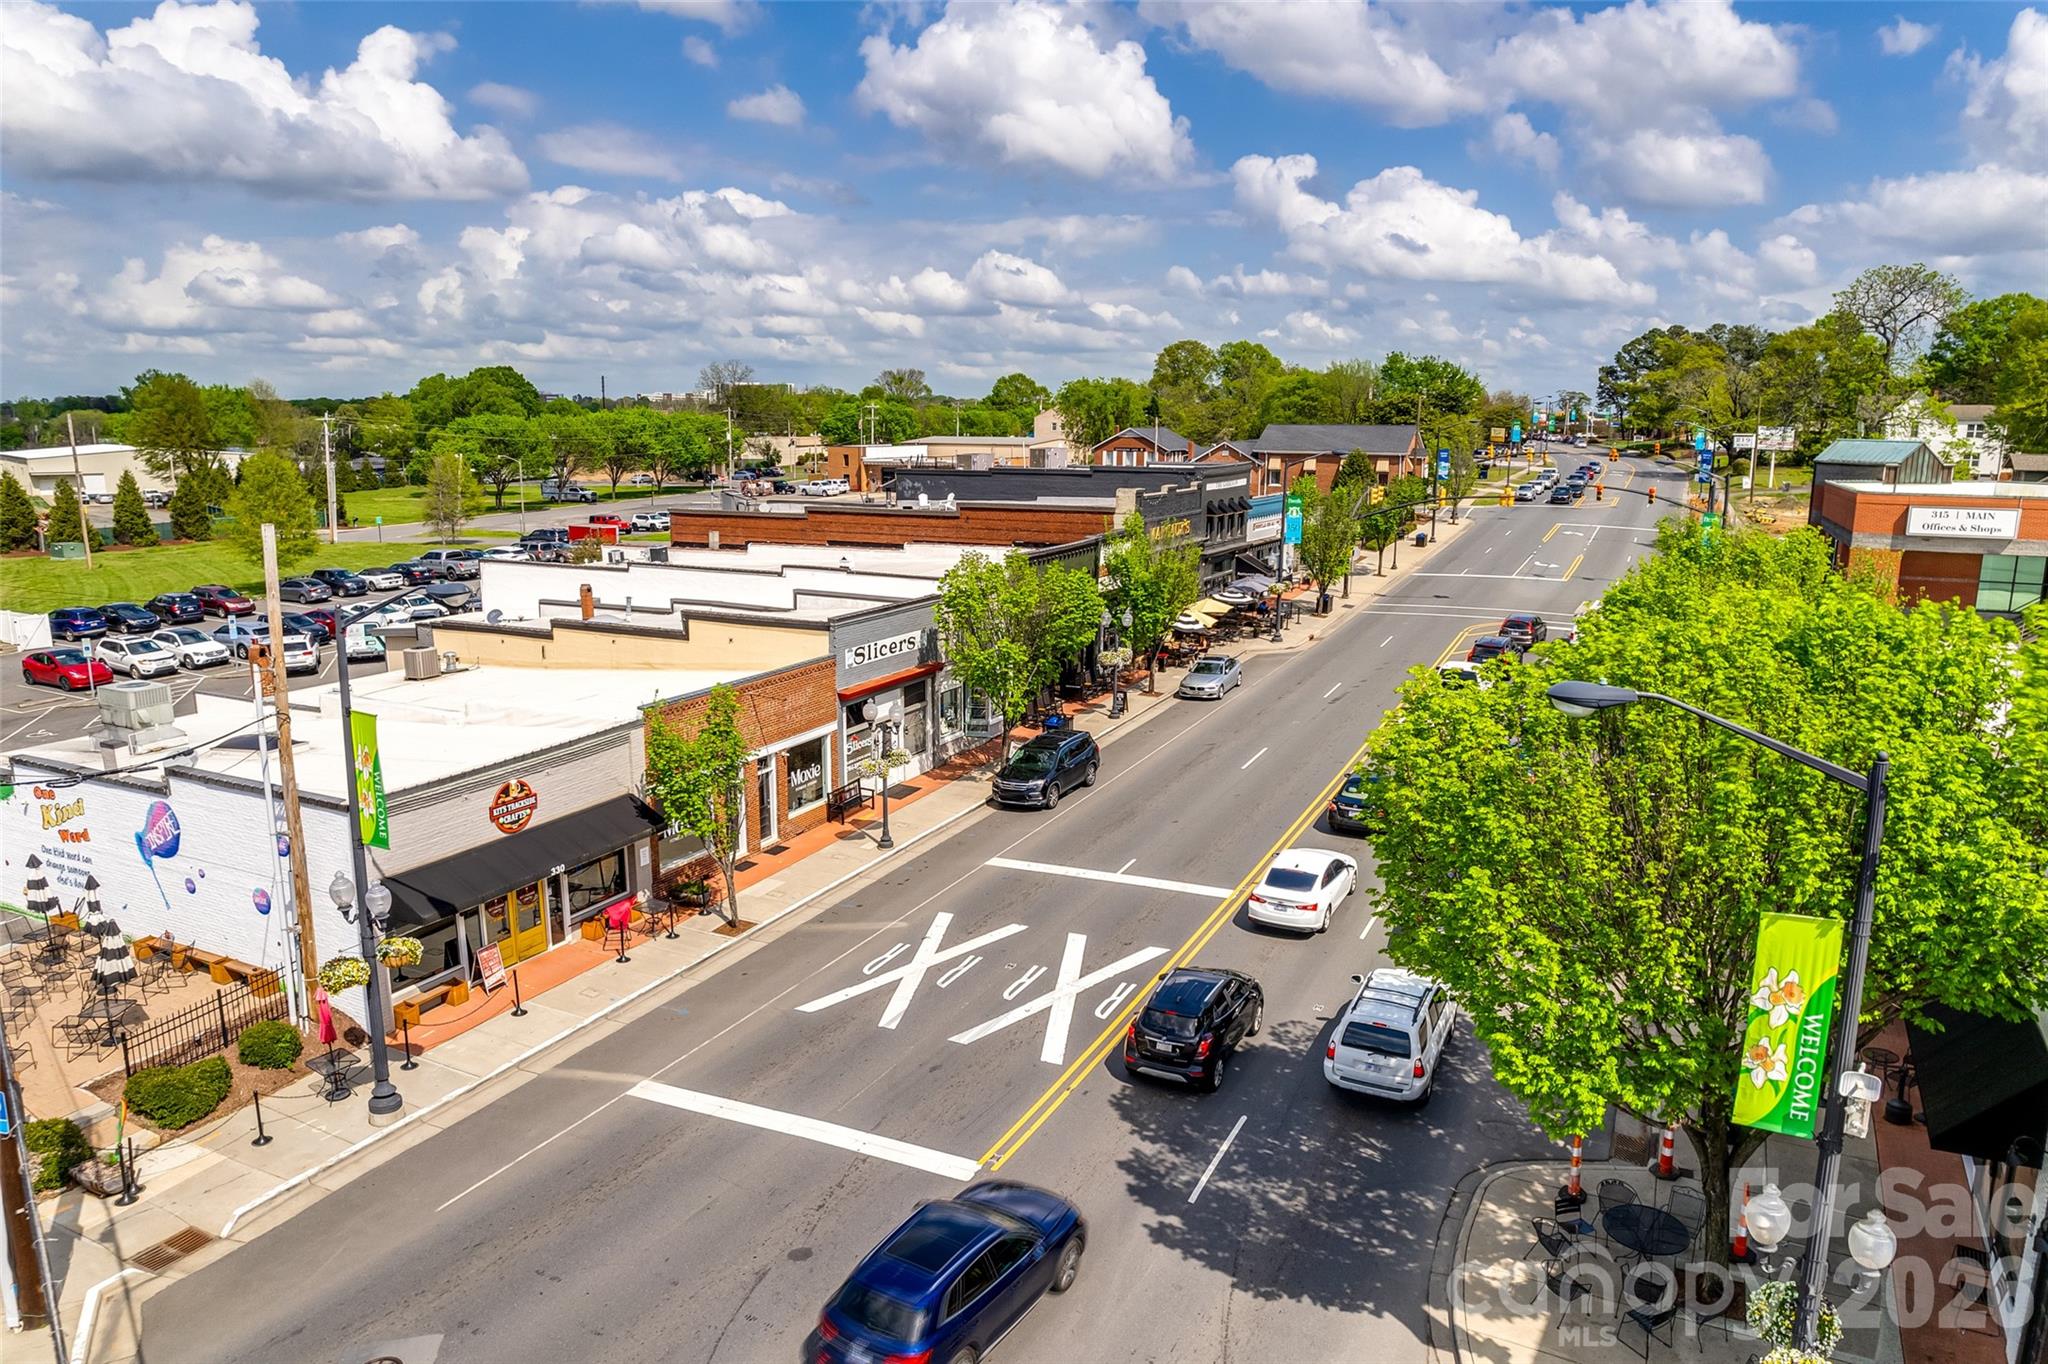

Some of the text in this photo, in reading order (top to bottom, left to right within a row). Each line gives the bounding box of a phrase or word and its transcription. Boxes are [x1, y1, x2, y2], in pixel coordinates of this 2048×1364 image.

[1922, 522, 2002, 534] Offices & Shops
[1931, 511, 1949, 519] 315
[1966, 511, 1996, 520] MAIN
[853, 636, 916, 665] Slicers
[790, 763, 821, 788] Moxie
[33, 786, 56, 800] One
[373, 771, 387, 839] WELCOME
[40, 797, 85, 830] Kind
[58, 828, 91, 843] Word
[145, 809, 181, 850] INSPIRE
[550, 864, 566, 876] 330
[1789, 1013, 1824, 1122] WELCOME
